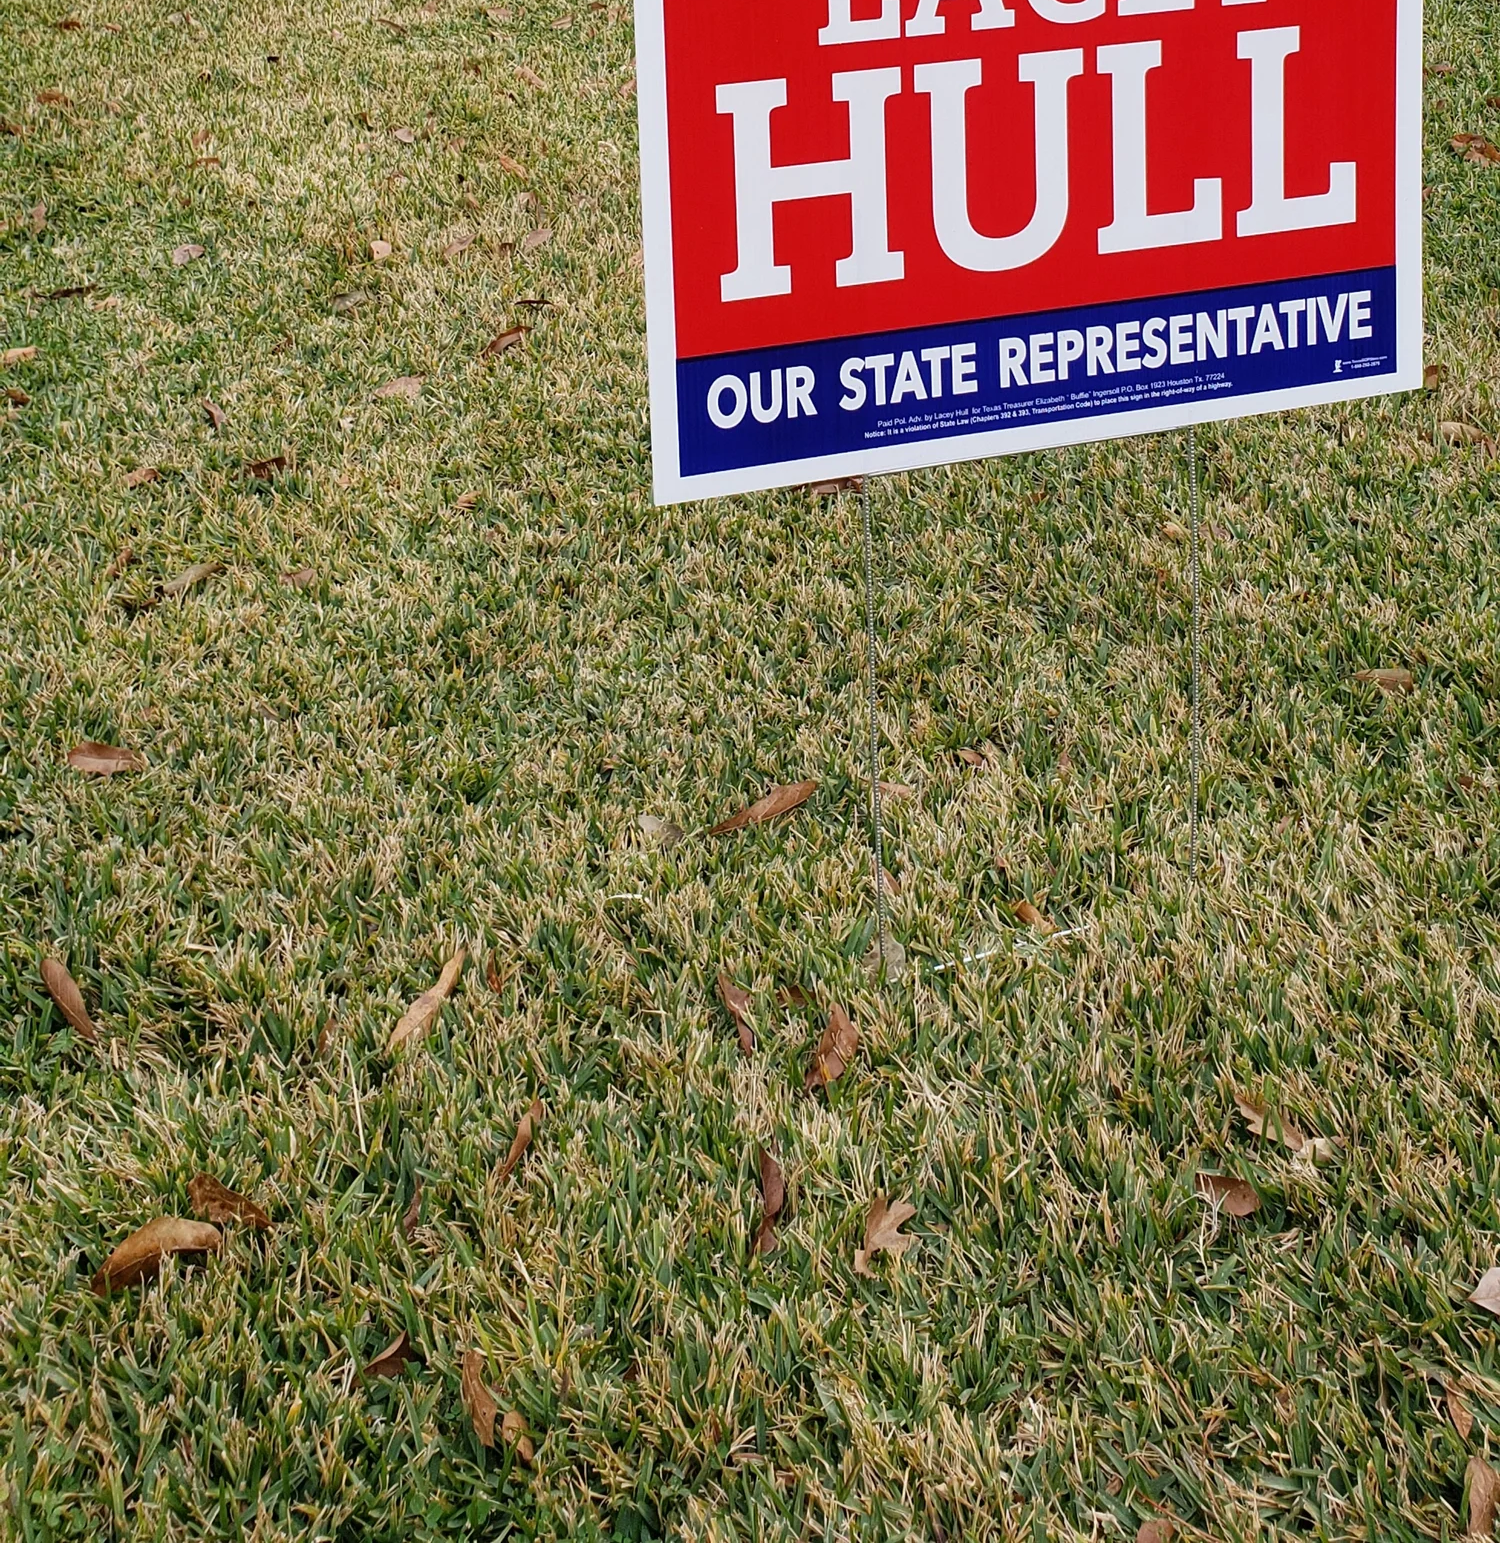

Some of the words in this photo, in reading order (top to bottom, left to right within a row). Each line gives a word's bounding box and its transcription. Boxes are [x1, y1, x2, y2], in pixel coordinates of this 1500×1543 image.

[716, 26, 1356, 302] HULL
[706, 365, 818, 429] OUR
[838, 342, 979, 411] STATE
[998, 289, 1373, 389] REPRESENTATIVE
[1003, 401, 1034, 409] Treasurer
[1036, 396, 1065, 405] Elizabeth
[1093, 388, 1119, 398] Ingersoll
[1167, 378, 1193, 386] Houston
[1206, 373, 1224, 381] 77224
[905, 424, 931, 432] violation
[1032, 404, 1074, 414] Transportation
[1101, 398, 1117, 406] place
[1161, 387, 1195, 397] right-of-way
